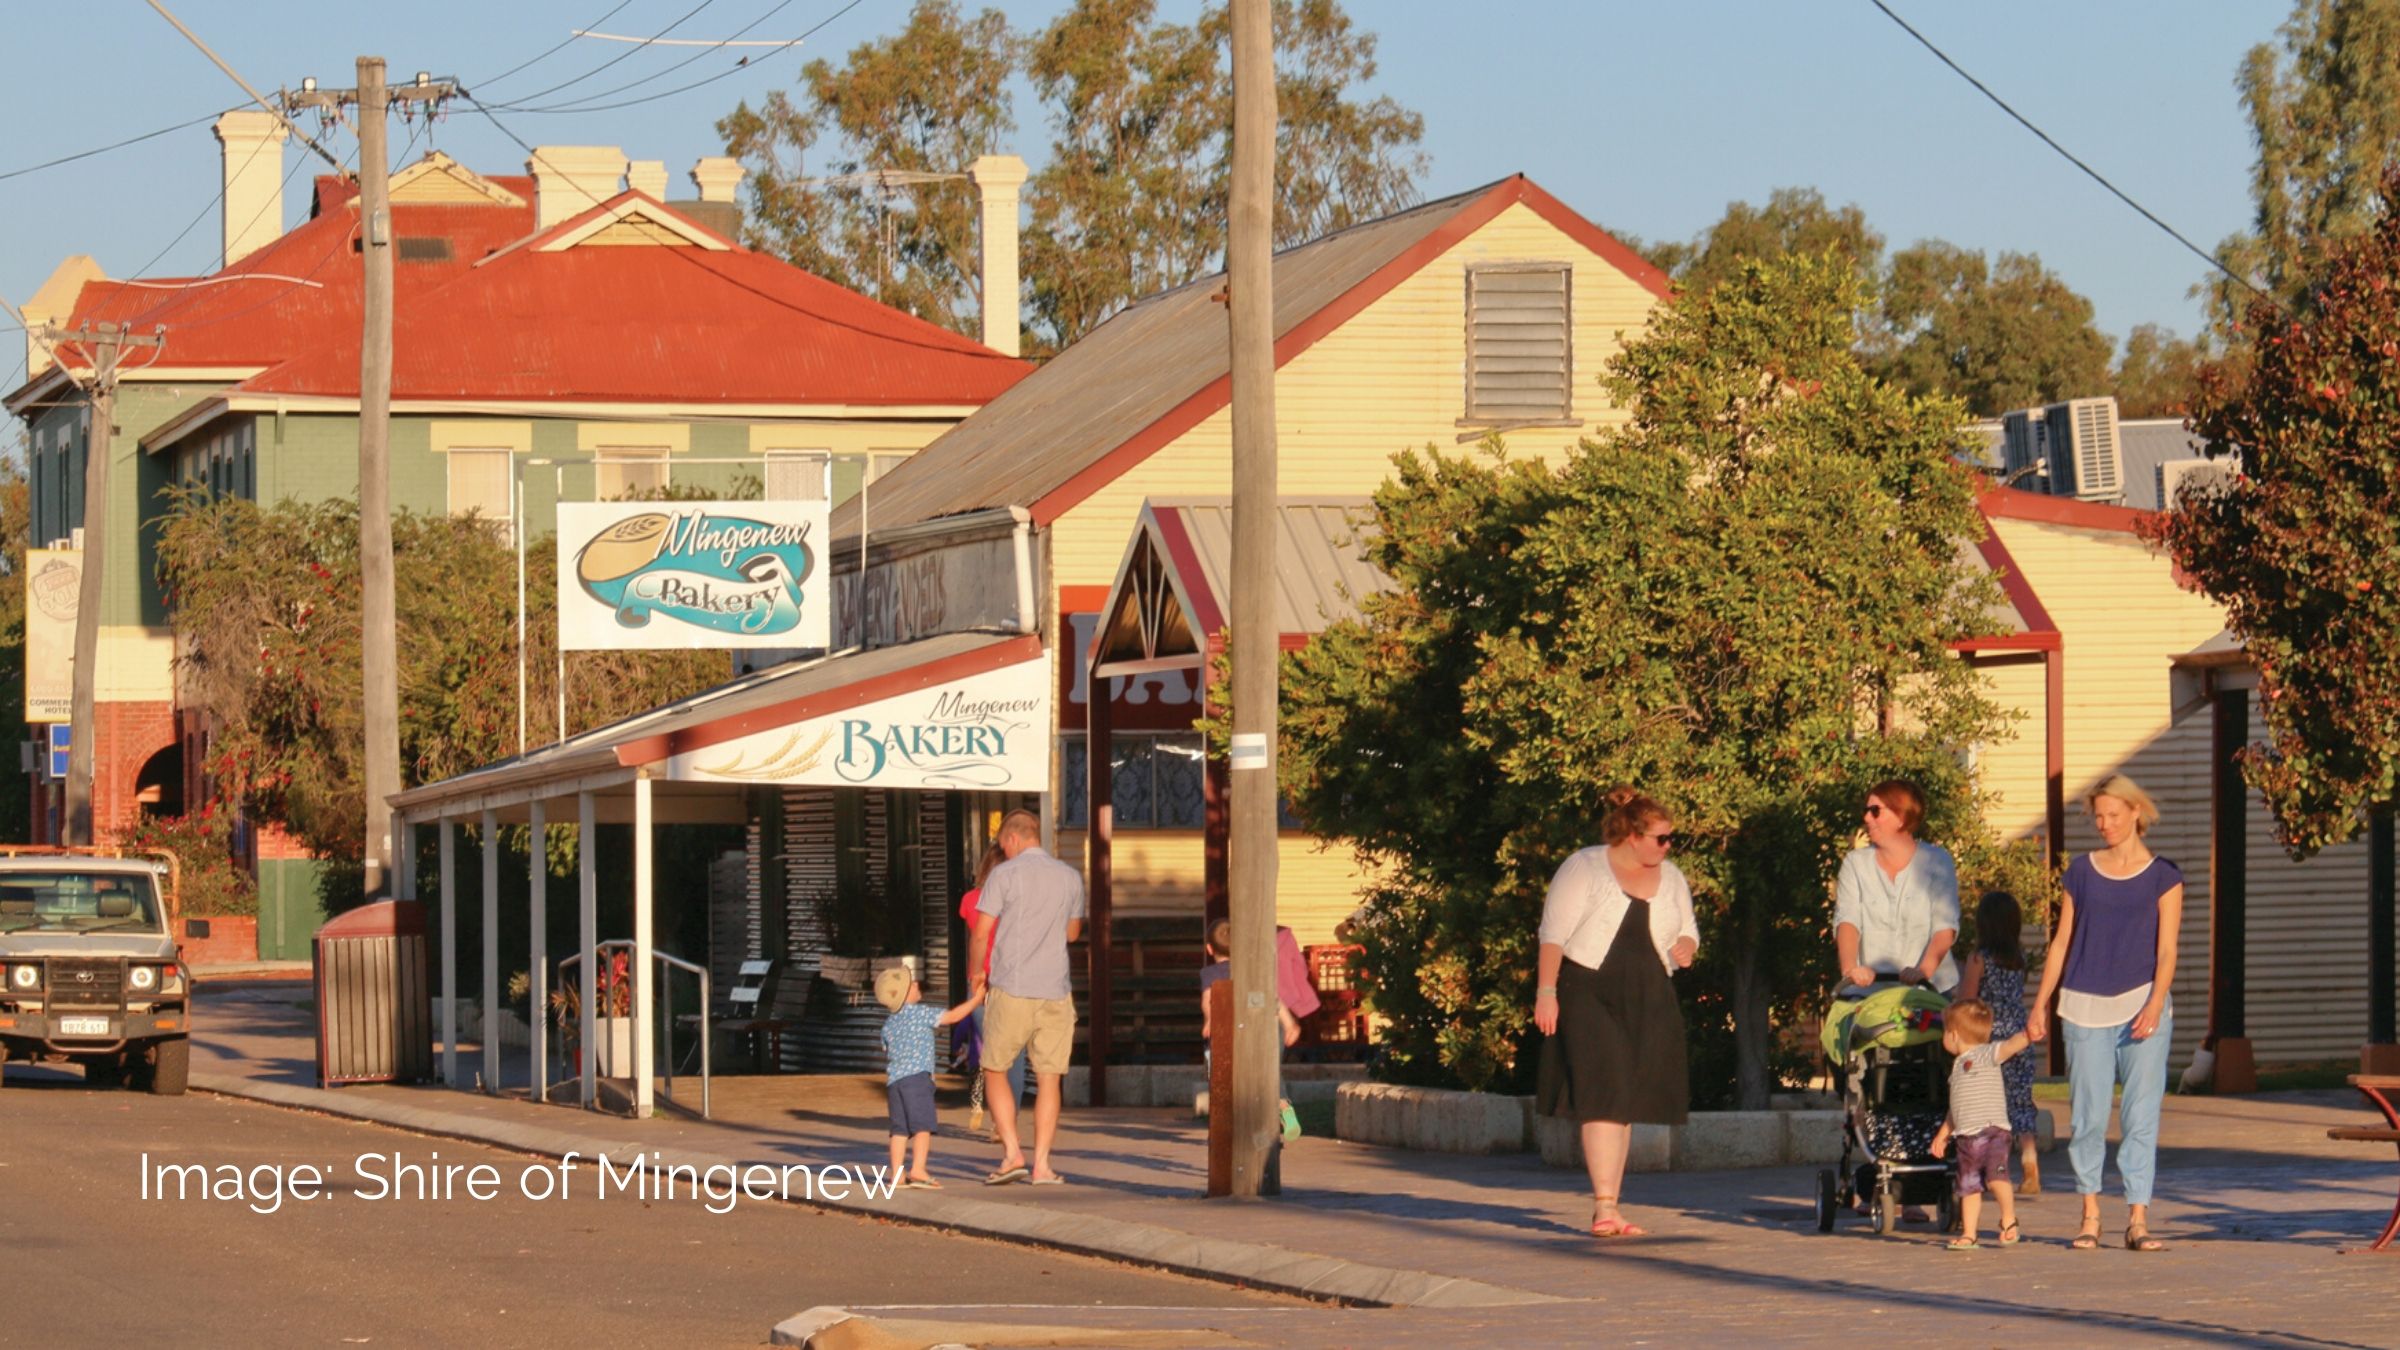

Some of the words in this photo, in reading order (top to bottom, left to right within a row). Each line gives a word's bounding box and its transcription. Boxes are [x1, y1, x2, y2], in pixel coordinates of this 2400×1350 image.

[653, 509, 811, 568] Mingenew
[657, 577, 782, 634] Bakery
[929, 690, 1040, 725] Mingenew
[835, 719, 1022, 782] BAKERY
